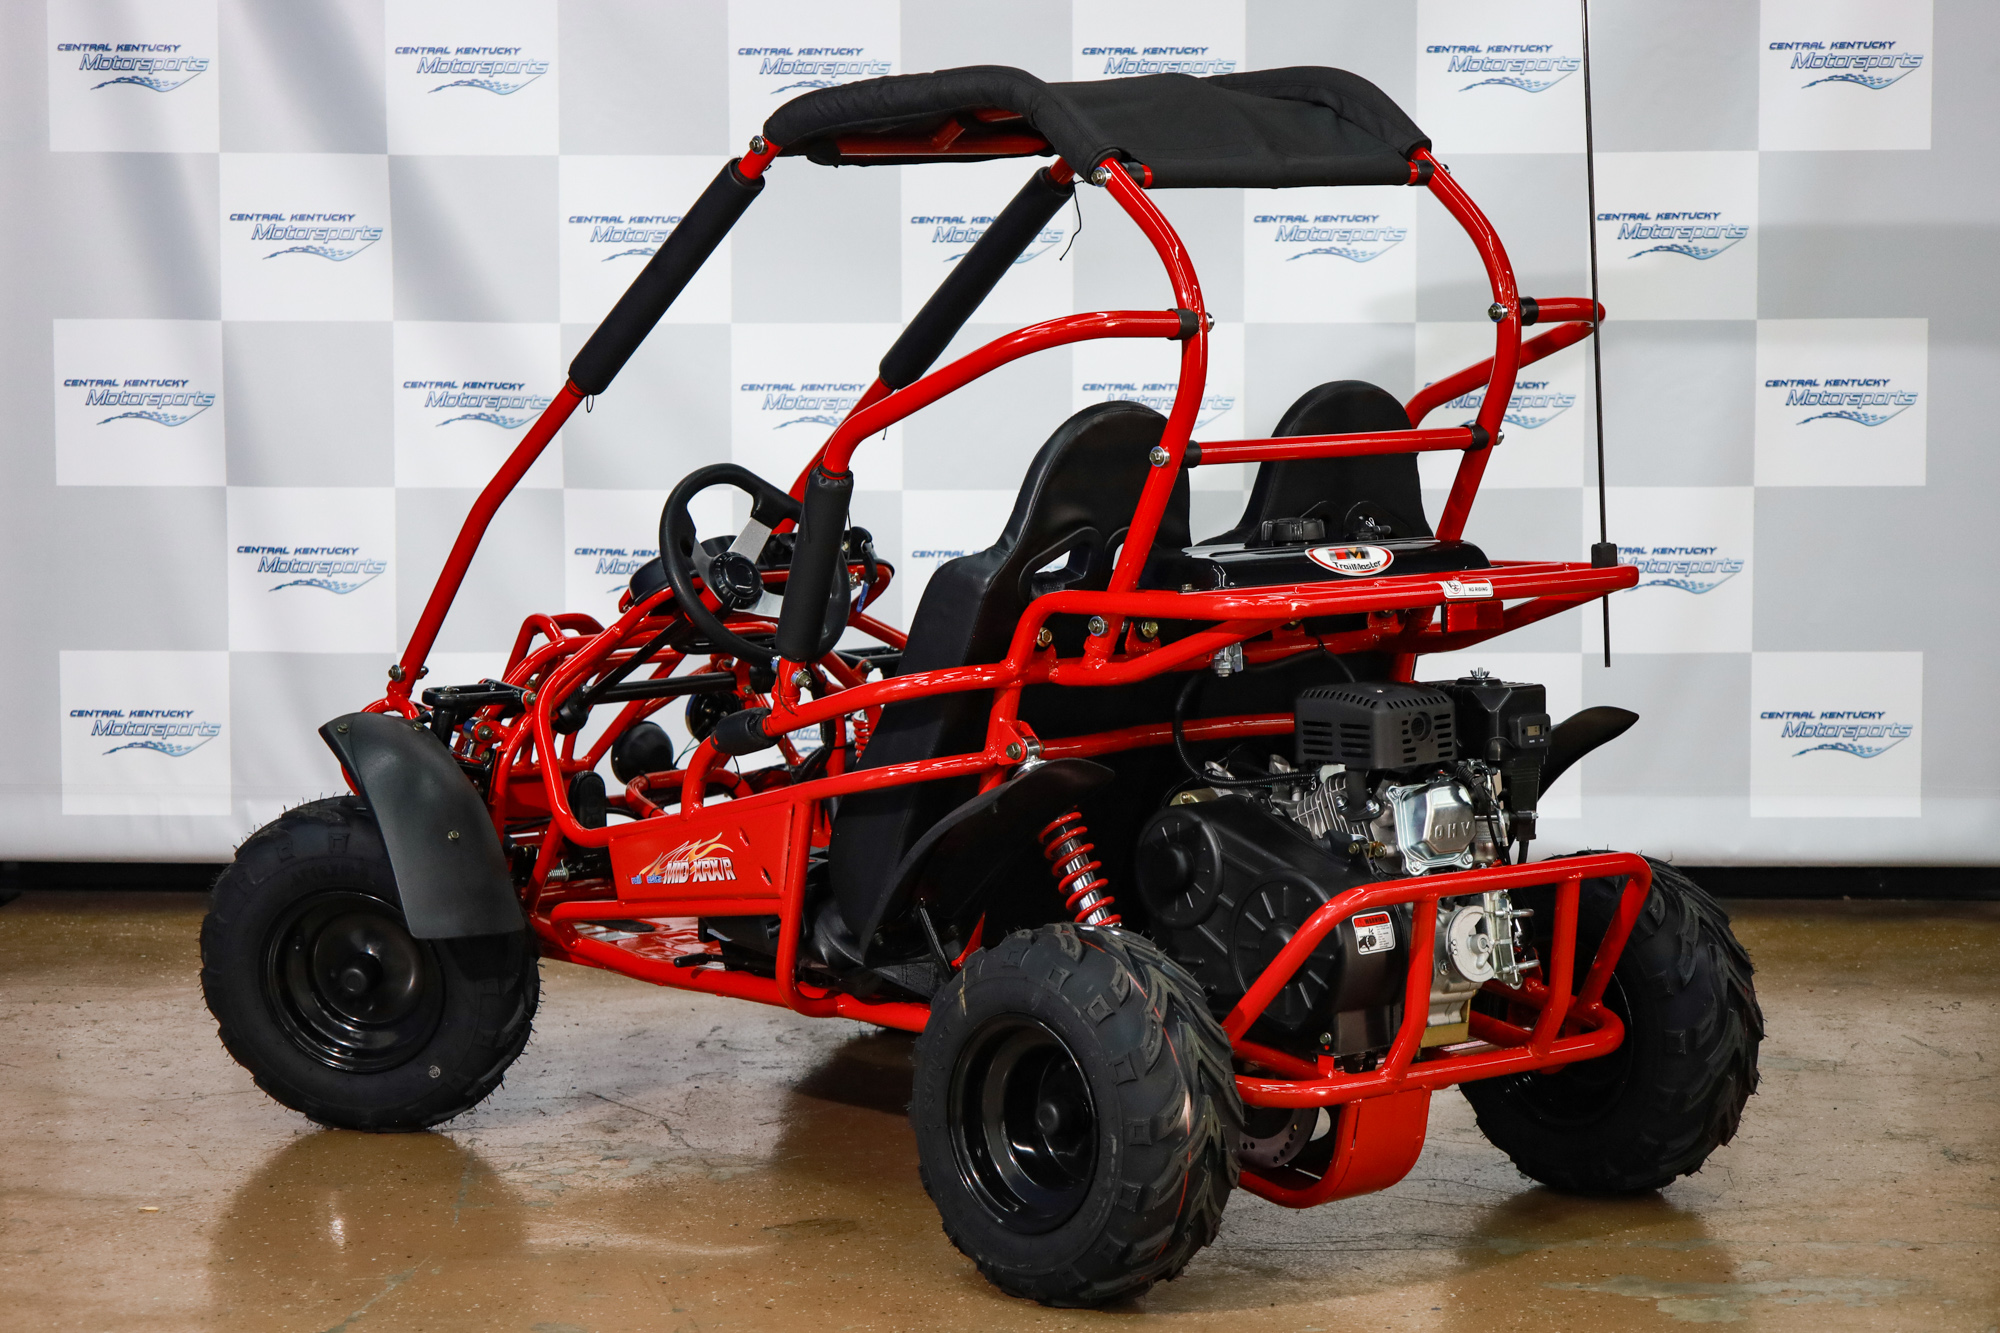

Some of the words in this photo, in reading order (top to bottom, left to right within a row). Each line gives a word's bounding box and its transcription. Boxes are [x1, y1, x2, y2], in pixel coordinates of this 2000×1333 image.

[57, 42, 114, 52] CENTRAL
[116, 42, 182, 53] KENTUCKY
[395, 46, 452, 56] CENTRAL
[455, 46, 523, 56] KENTUCKY
[1425, 44, 1483, 54] CENTRAL
[1486, 44, 1553, 54] KENTUCKY
[1769, 40, 1827, 51] CENTRAL
[1830, 40, 1897, 50] KENTUCKY
[737, 47, 794, 57] CENTRAL
[797, 47, 865, 57] KENTUCKY
[1081, 46, 1138, 56] CENTRAL
[1142, 46, 1209, 57] KENTUCKY
[80, 52, 211, 74] Motorsports
[417, 56, 550, 78] Motorsports
[1103, 56, 1237, 75] Motorsports
[1448, 54, 1582, 76] Motorsports
[1791, 51, 1925, 73] Motorsports
[760, 57, 892, 79] Motorsports
[229, 212, 287, 222] CENTRAL
[290, 213, 357, 223] KENTUCKY
[568, 215, 625, 225] CENTRAL
[628, 215, 685, 225] KENTUC
[911, 215, 968, 225] CENTRAL
[1253, 214, 1310, 224] CENTRAL
[1313, 214, 1380, 224] KENTUCKY
[1596, 212, 1652, 222] CENTRAL
[1655, 211, 1721, 221] KENTUCKY
[252, 223, 385, 245] Motorsports
[589, 225, 674, 243] Motors
[1275, 224, 1408, 246] Motorsports
[1617, 222, 1750, 244] Motorsports
[64, 378, 121, 388] CENTRAL
[123, 378, 190, 388] KENTUCKY
[403, 380, 460, 390] CENTRAL
[462, 380, 527, 391] KENTUCKY
[741, 383, 797, 392] CENTRAL
[800, 383, 867, 392] KENTUCKY
[1082, 383, 1138, 392] CENTRAL
[1764, 378, 1821, 388] CENTRAL
[1824, 377, 1891, 387] KENTUCKY
[87, 388, 217, 410] Motorsports
[762, 393, 864, 414] Motorsp
[1786, 388, 1919, 410] Motorsports
[237, 545, 291, 556] CENTRAL
[294, 546, 361, 556] KENTUCKY
[574, 547, 630, 557] CENTRAL
[911, 549, 965, 558] CENTRAL
[1616, 546, 1648, 555] TRAL
[1651, 546, 1718, 556] KENTUCKY
[258, 555, 388, 577] Motorsports
[1332, 560, 1381, 570] TrailMaster
[70, 708, 126, 718] CENTRAL
[129, 709, 196, 719] KENTUCKY
[1759, 710, 1816, 720] CENTRAL
[1819, 710, 1886, 720] KENTUCKY
[92, 719, 223, 741] Motorsports
[1782, 720, 1913, 742] Motorsports
[1434, 821, 1471, 840] OHV
[662, 859, 690, 885] MID
